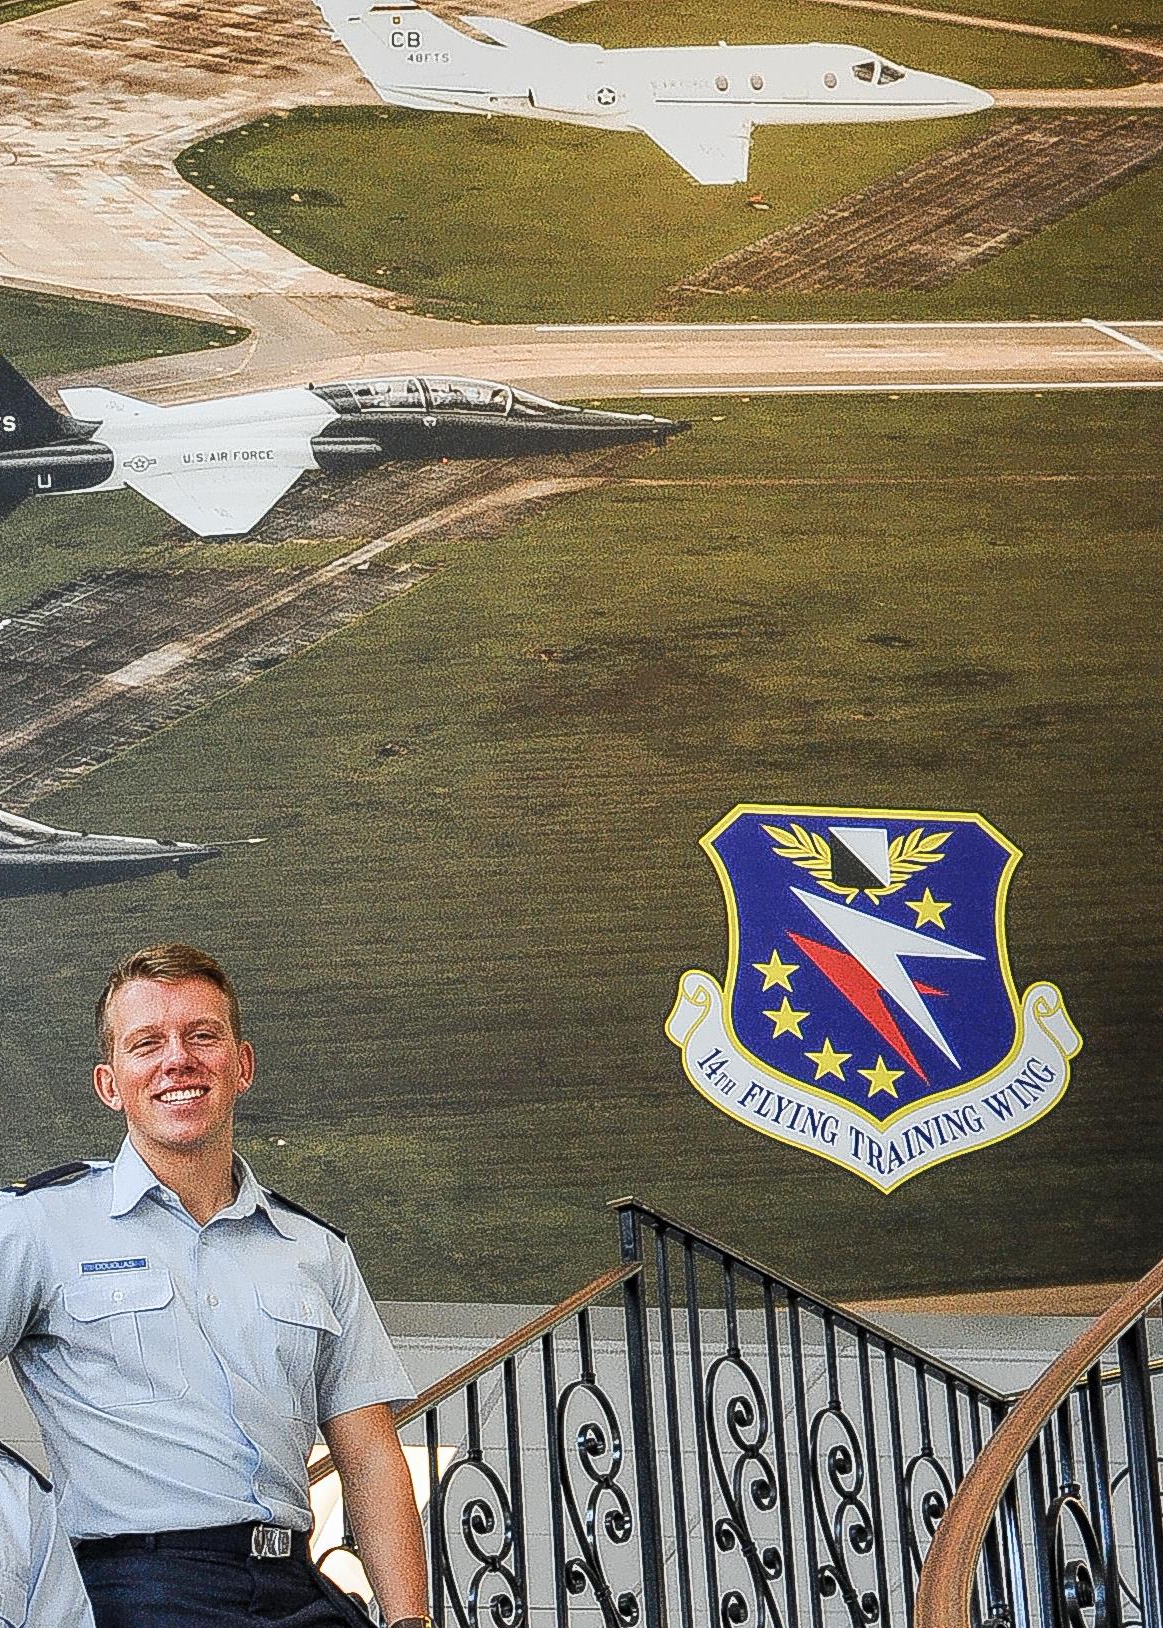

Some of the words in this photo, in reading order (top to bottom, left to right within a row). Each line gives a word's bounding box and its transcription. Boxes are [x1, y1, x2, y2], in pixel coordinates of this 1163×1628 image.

[391, 31, 421, 48] CB
[209, 451, 228, 462] AIR
[233, 450, 275, 461] FORCE
[696, 1047, 737, 1096] 14TH
[737, 1081, 840, 1147] FLYING
[849, 1104, 985, 1175] TRAINING
[981, 1056, 1057, 1122] WING
